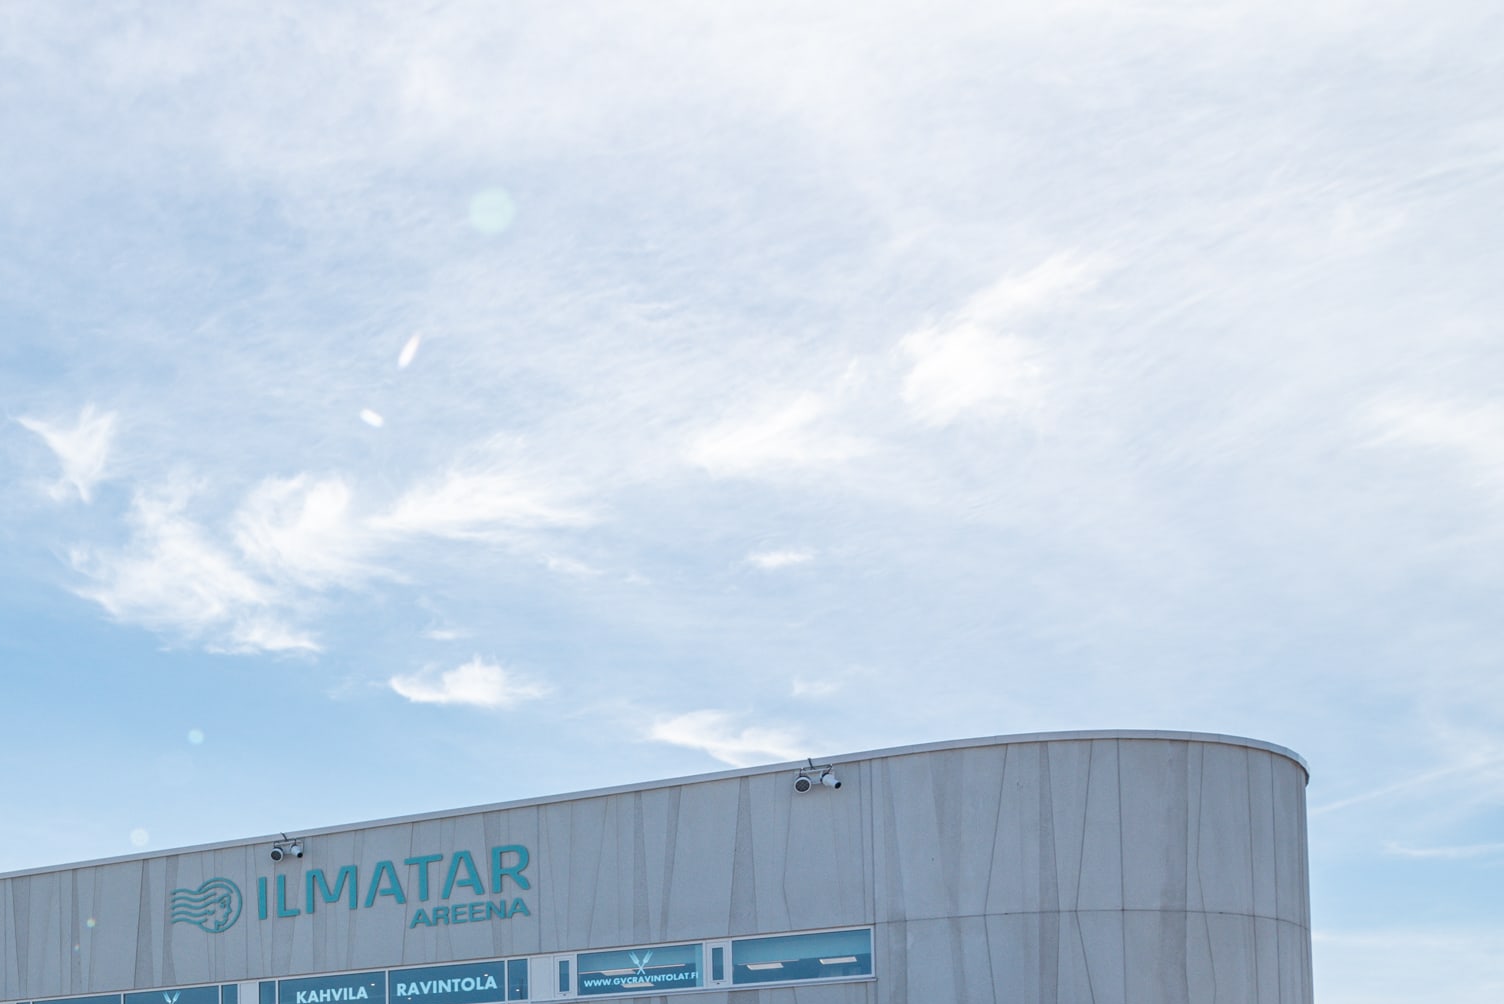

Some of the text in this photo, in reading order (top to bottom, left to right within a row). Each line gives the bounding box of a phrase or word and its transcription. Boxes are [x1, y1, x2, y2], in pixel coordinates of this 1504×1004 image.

[258, 844, 531, 920] ILMATAR
[409, 897, 530, 928] AREENA
[296, 975, 498, 1004] KAHVILA RAVINTOLA
[583, 971, 699, 987] WWW.GVCRAVINTOLAT.FI
